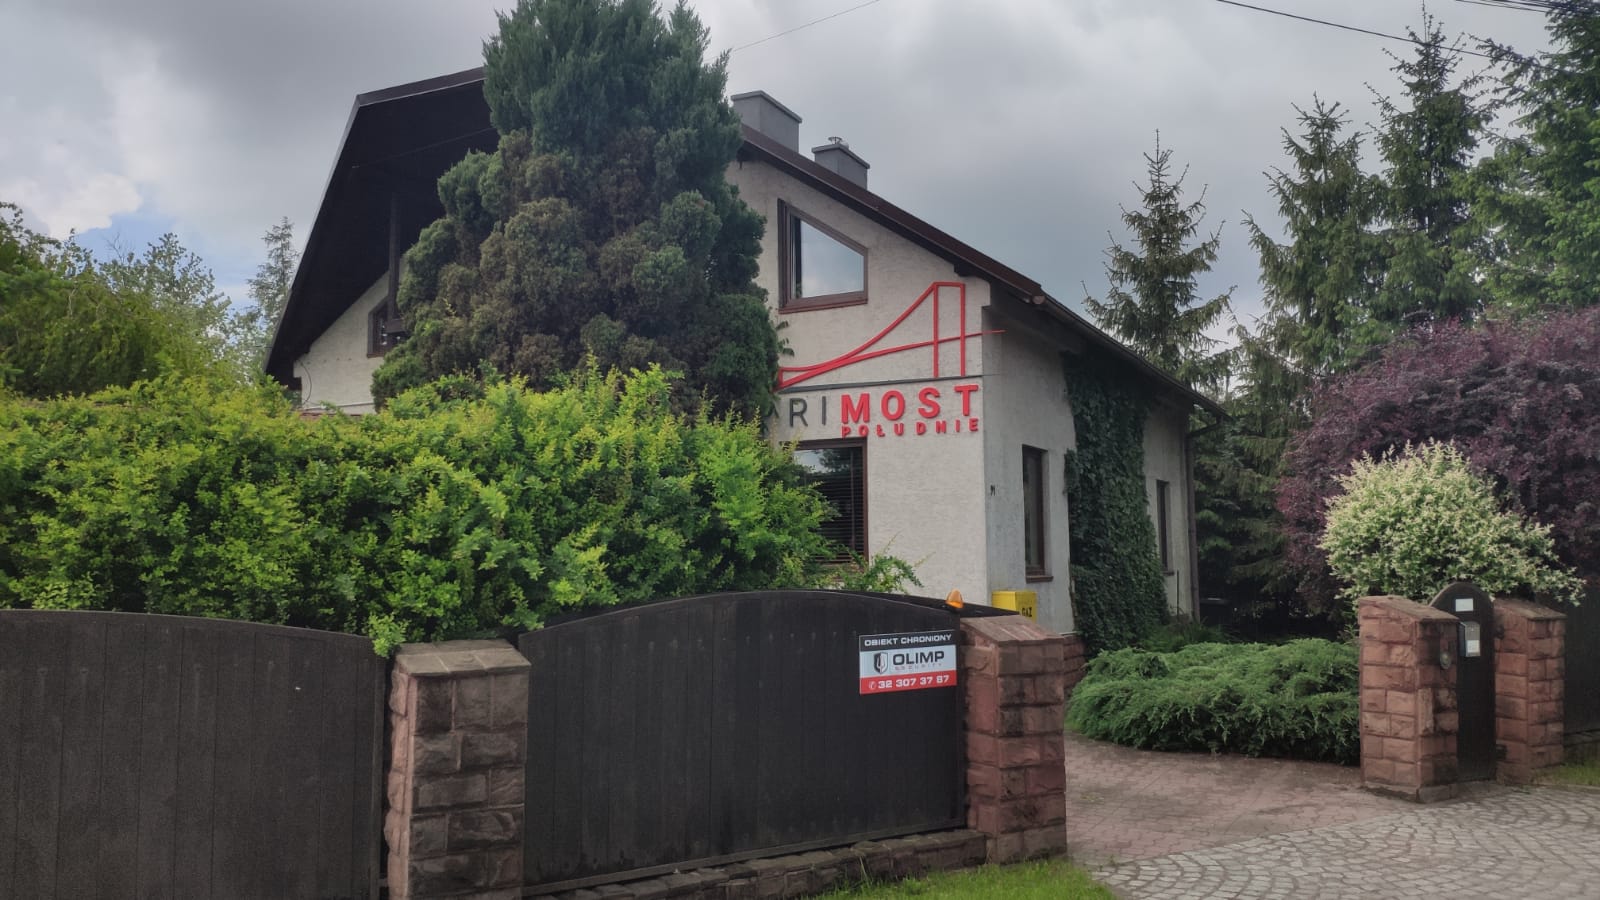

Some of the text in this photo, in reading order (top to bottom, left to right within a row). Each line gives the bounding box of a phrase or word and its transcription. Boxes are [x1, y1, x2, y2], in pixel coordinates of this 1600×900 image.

[788, 384, 979, 427] RIMOST
[841, 418, 979, 438] POŁUDNIE
[864, 633, 952, 647] OBIEKT CHRONIONY
[892, 650, 945, 666] OLIMP
[878, 680, 893, 689] 32
[895, 678, 917, 688] 307
[919, 676, 934, 686] 37
